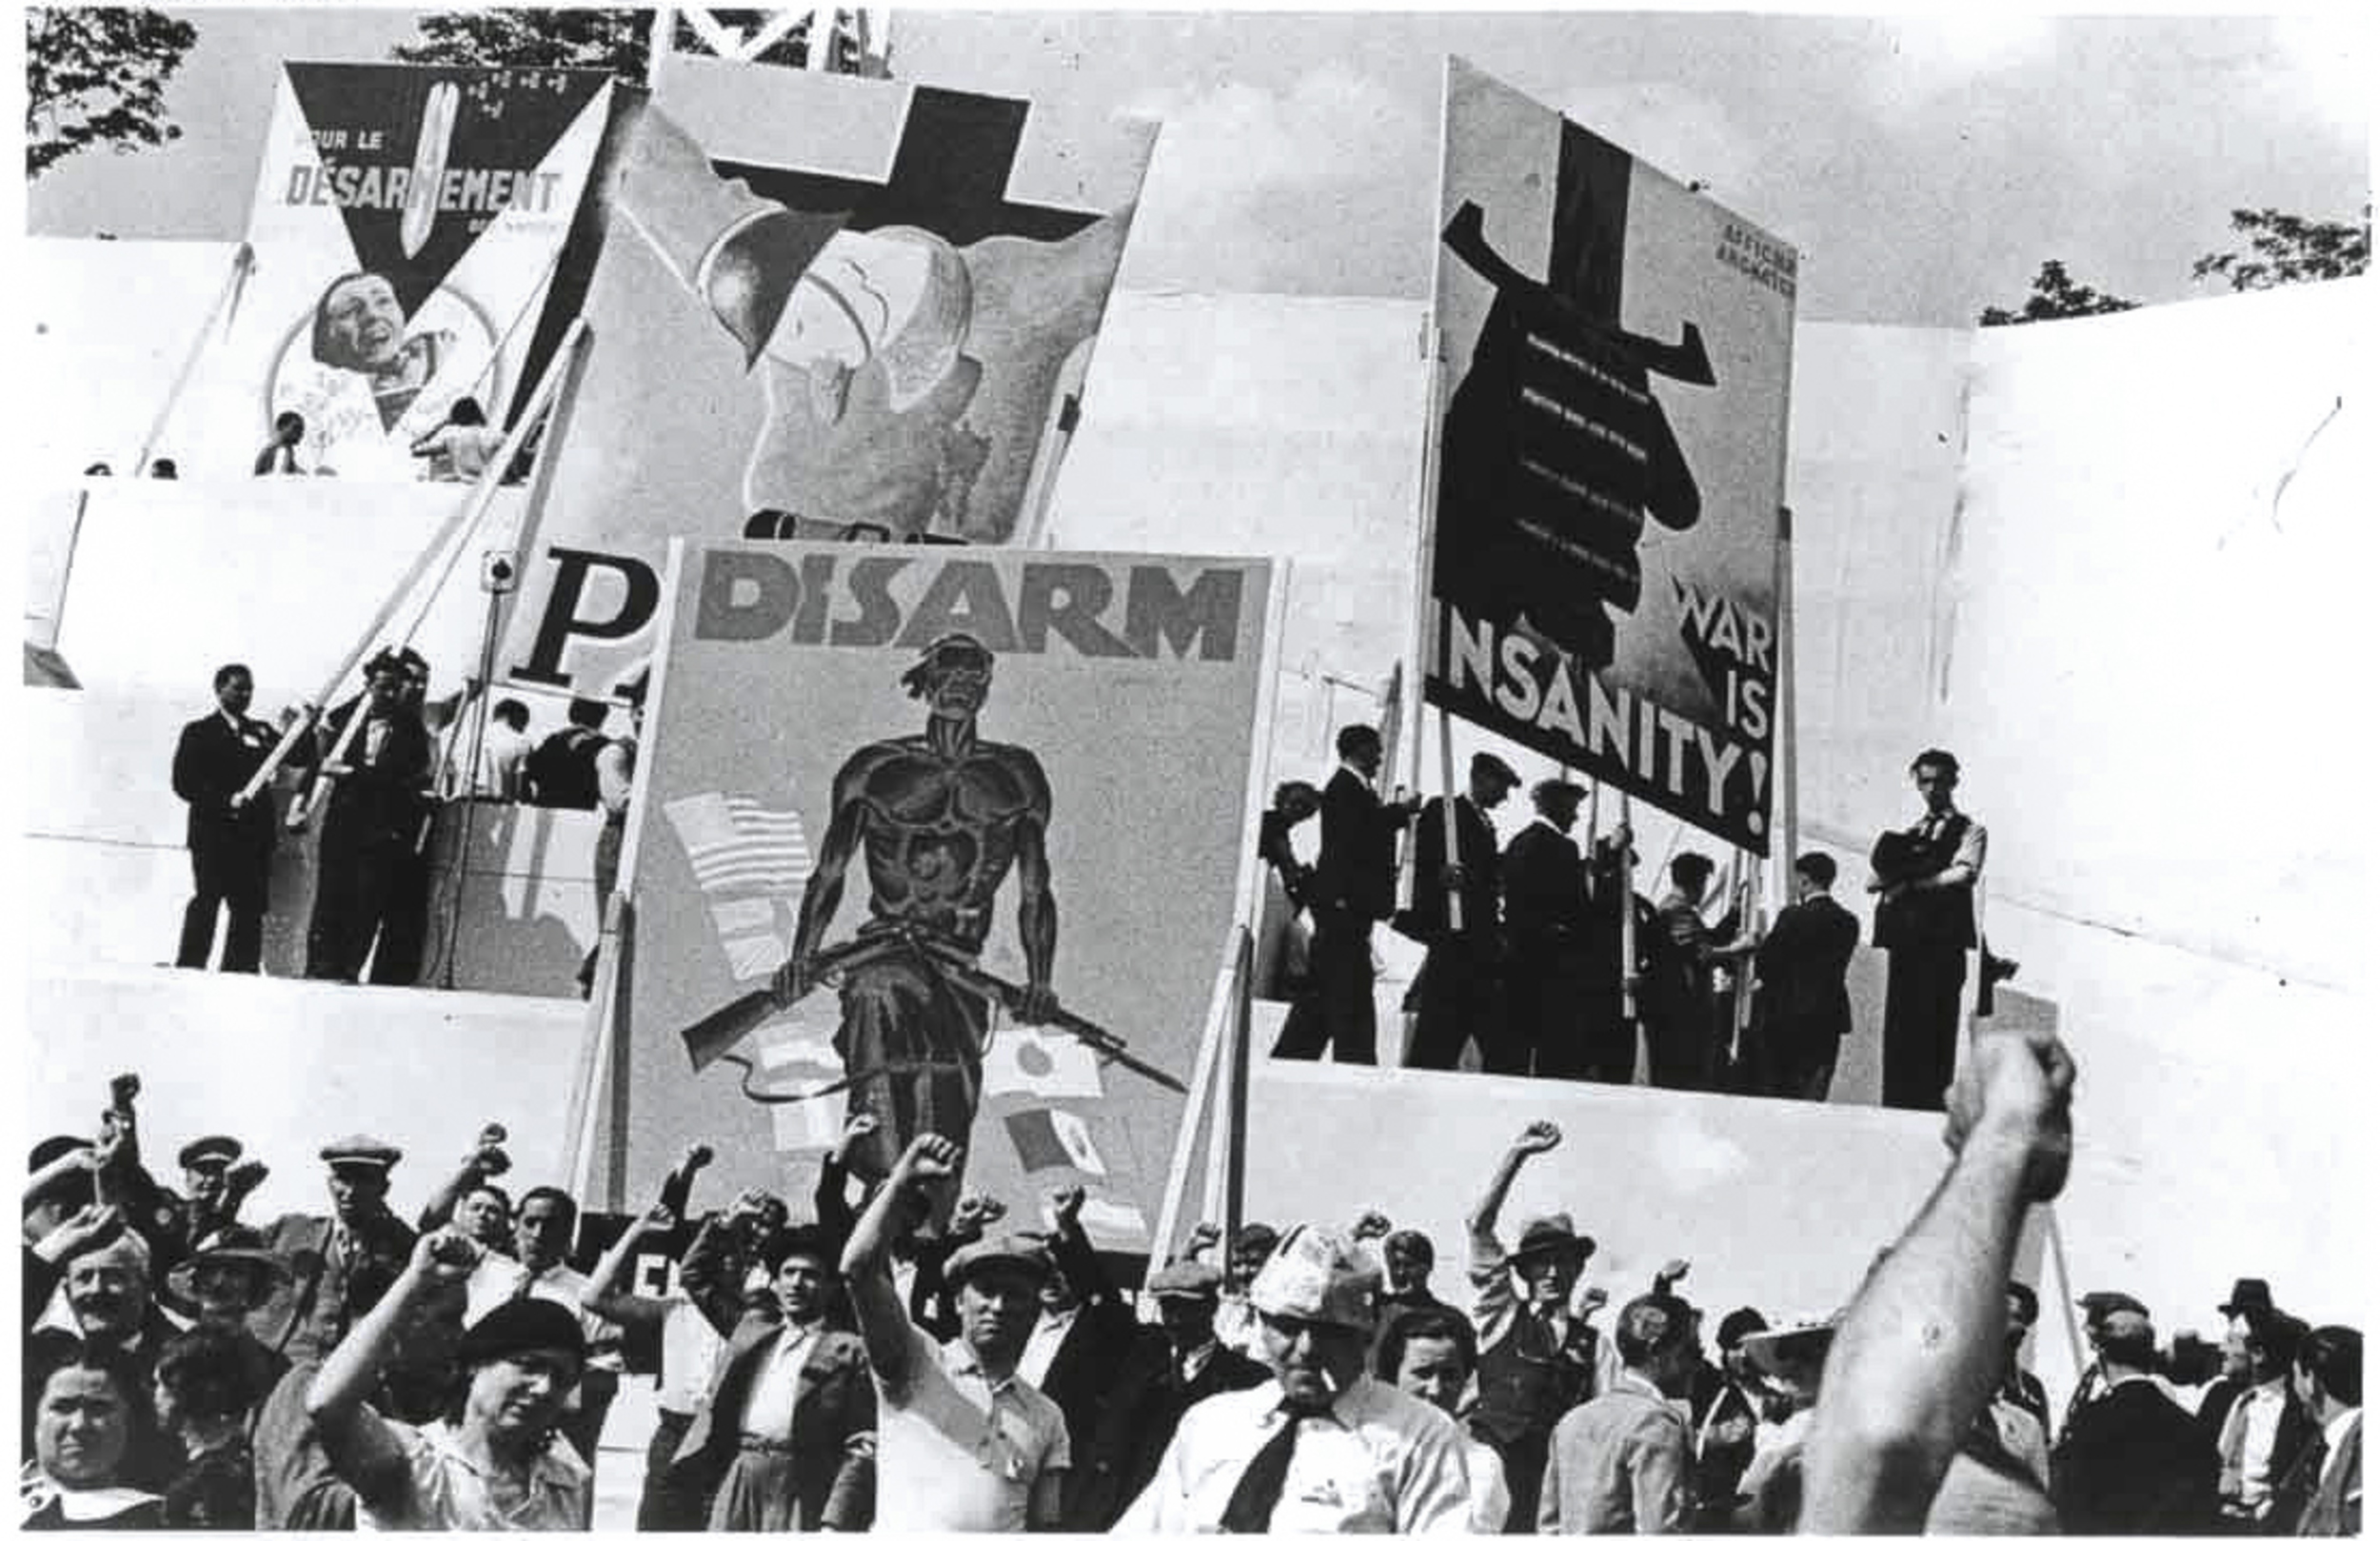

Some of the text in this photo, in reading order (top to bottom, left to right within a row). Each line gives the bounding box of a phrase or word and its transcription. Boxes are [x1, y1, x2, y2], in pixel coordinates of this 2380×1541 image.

[301, 129, 384, 149] OUR LE
[509, 546, 660, 702] P
[694, 549, 1245, 662] DISARM
[1673, 576, 1773, 673] WAR
[1726, 669, 1768, 740] IS
